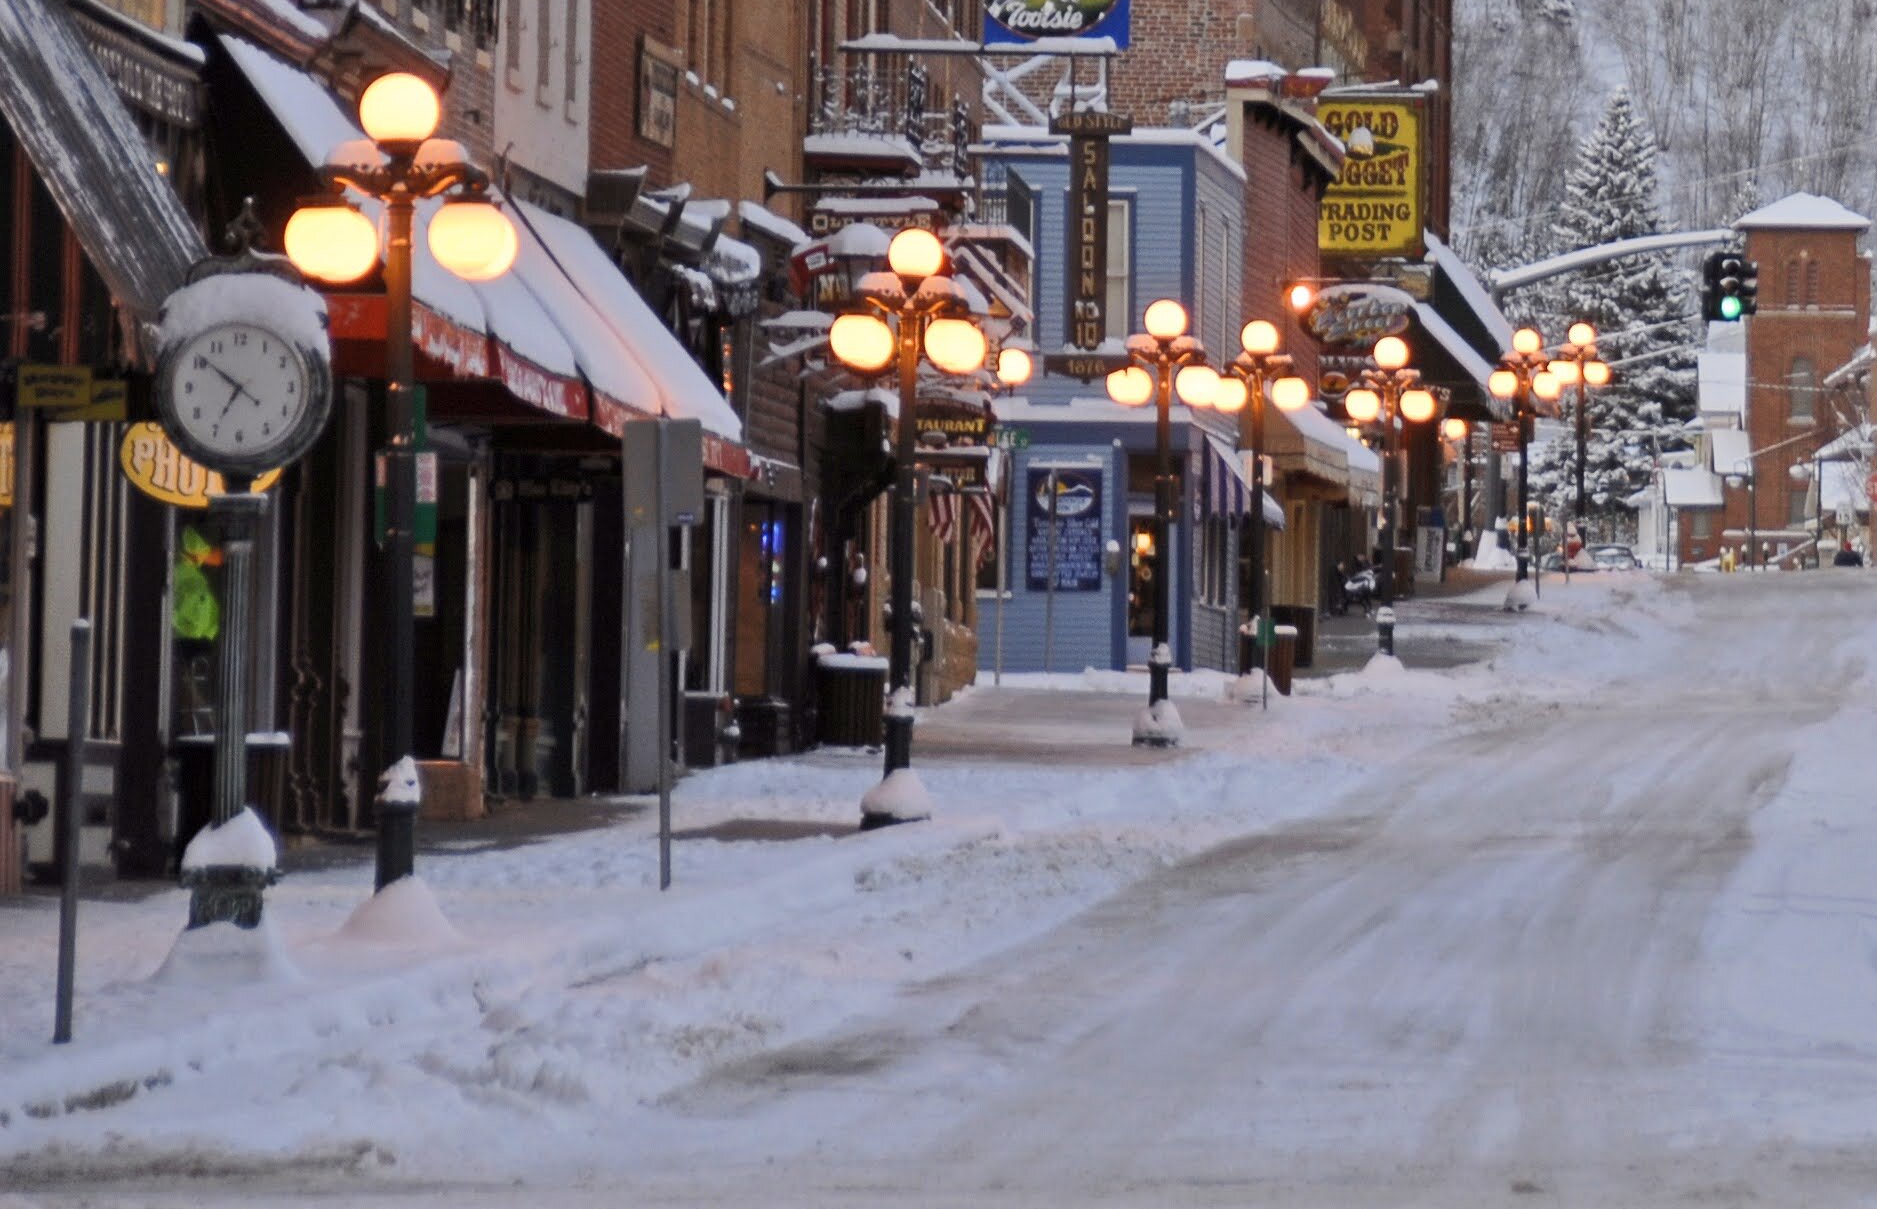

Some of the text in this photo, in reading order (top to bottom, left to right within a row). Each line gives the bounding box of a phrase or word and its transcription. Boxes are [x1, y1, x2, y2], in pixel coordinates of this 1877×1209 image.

[1006, 0, 1084, 30] Tootsie
[1324, 109, 1399, 139] GOLD
[1081, 141, 1097, 296] SALOON
[1319, 202, 1412, 221] TRADING
[1328, 222, 1392, 242] POST
[233, 332, 248, 346] 12
[209, 341, 224, 354] 11
[261, 341, 269, 354] 1
[193, 355, 208, 369] 10
[279, 355, 286, 369] 2
[185, 381, 193, 394] 9
[212, 424, 219, 438] 7
[235, 430, 244, 443] 6
